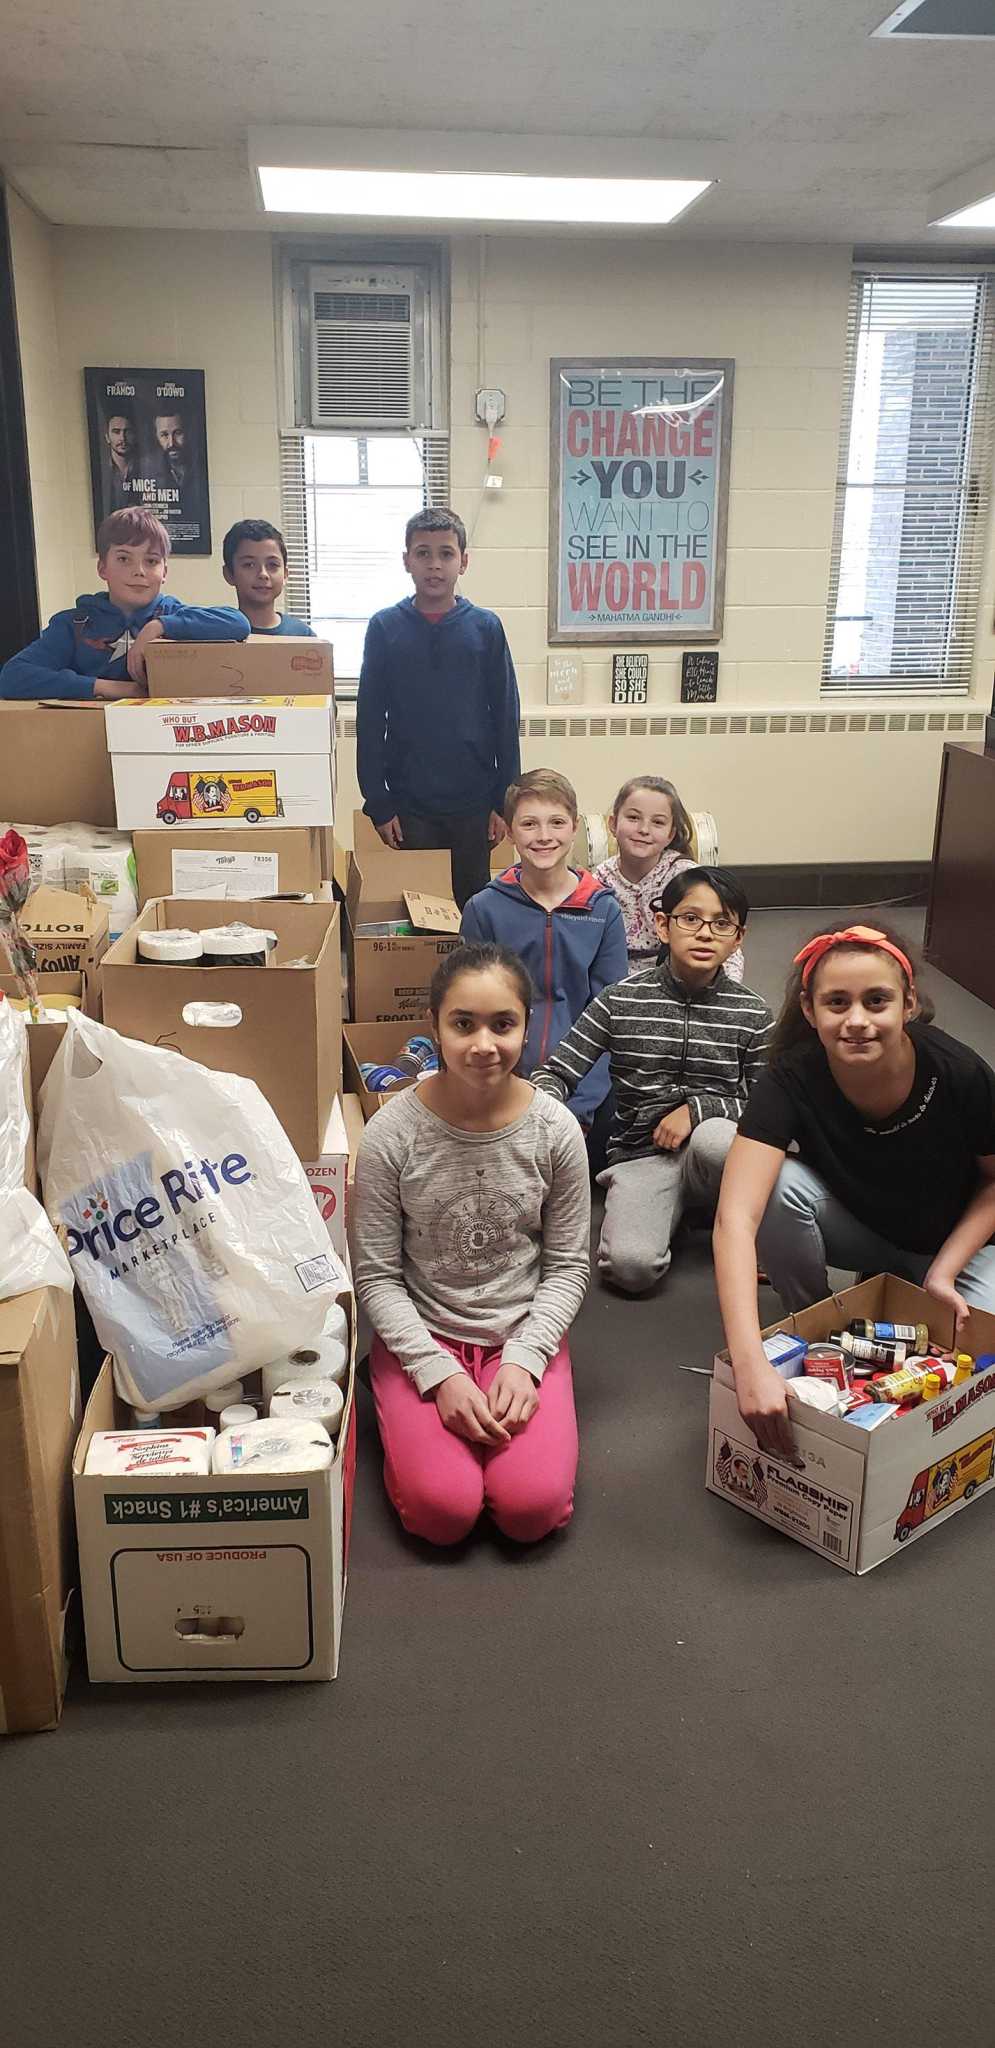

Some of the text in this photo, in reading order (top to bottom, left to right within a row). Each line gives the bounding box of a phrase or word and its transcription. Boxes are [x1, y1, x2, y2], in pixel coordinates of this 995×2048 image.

[107, 386, 135, 396] FRANCO
[157, 387, 184, 397] O'DOWD
[568, 380, 715, 406] BE THE
[567, 409, 714, 457] CHANGE
[123, 479, 156, 491] OF MICE
[591, 460, 686, 499] YOU
[143, 489, 179, 502] AND MEN
[568, 501, 710, 531] WANT TO
[568, 534, 708, 559] SEE IN THE
[567, 561, 706, 612] WORLD
[597, 613, 675, 622] MAHATMA GANDHI
[616, 656, 648, 667] SHE BELIEVED
[615, 668, 647, 679] SHE COULD
[615, 680, 646, 691] SO SHE
[615, 691, 646, 702] DID
[162, 716, 180, 724] WHO
[22, 923, 84, 932] BOTTO
[306, 1168, 336, 1176] OZEN
[67, 1153, 251, 1261] Price Rite
[109, 1212, 216, 1280] MARKETPLACE
[767, 1464, 848, 1511] FLAGSHIP
[112, 1496, 303, 1519] America's #1 Snack
[802, 1493, 821, 1508] Copy
[824, 1504, 847, 1520] Paper
[156, 1551, 267, 1562] PRODUCE OF USA
